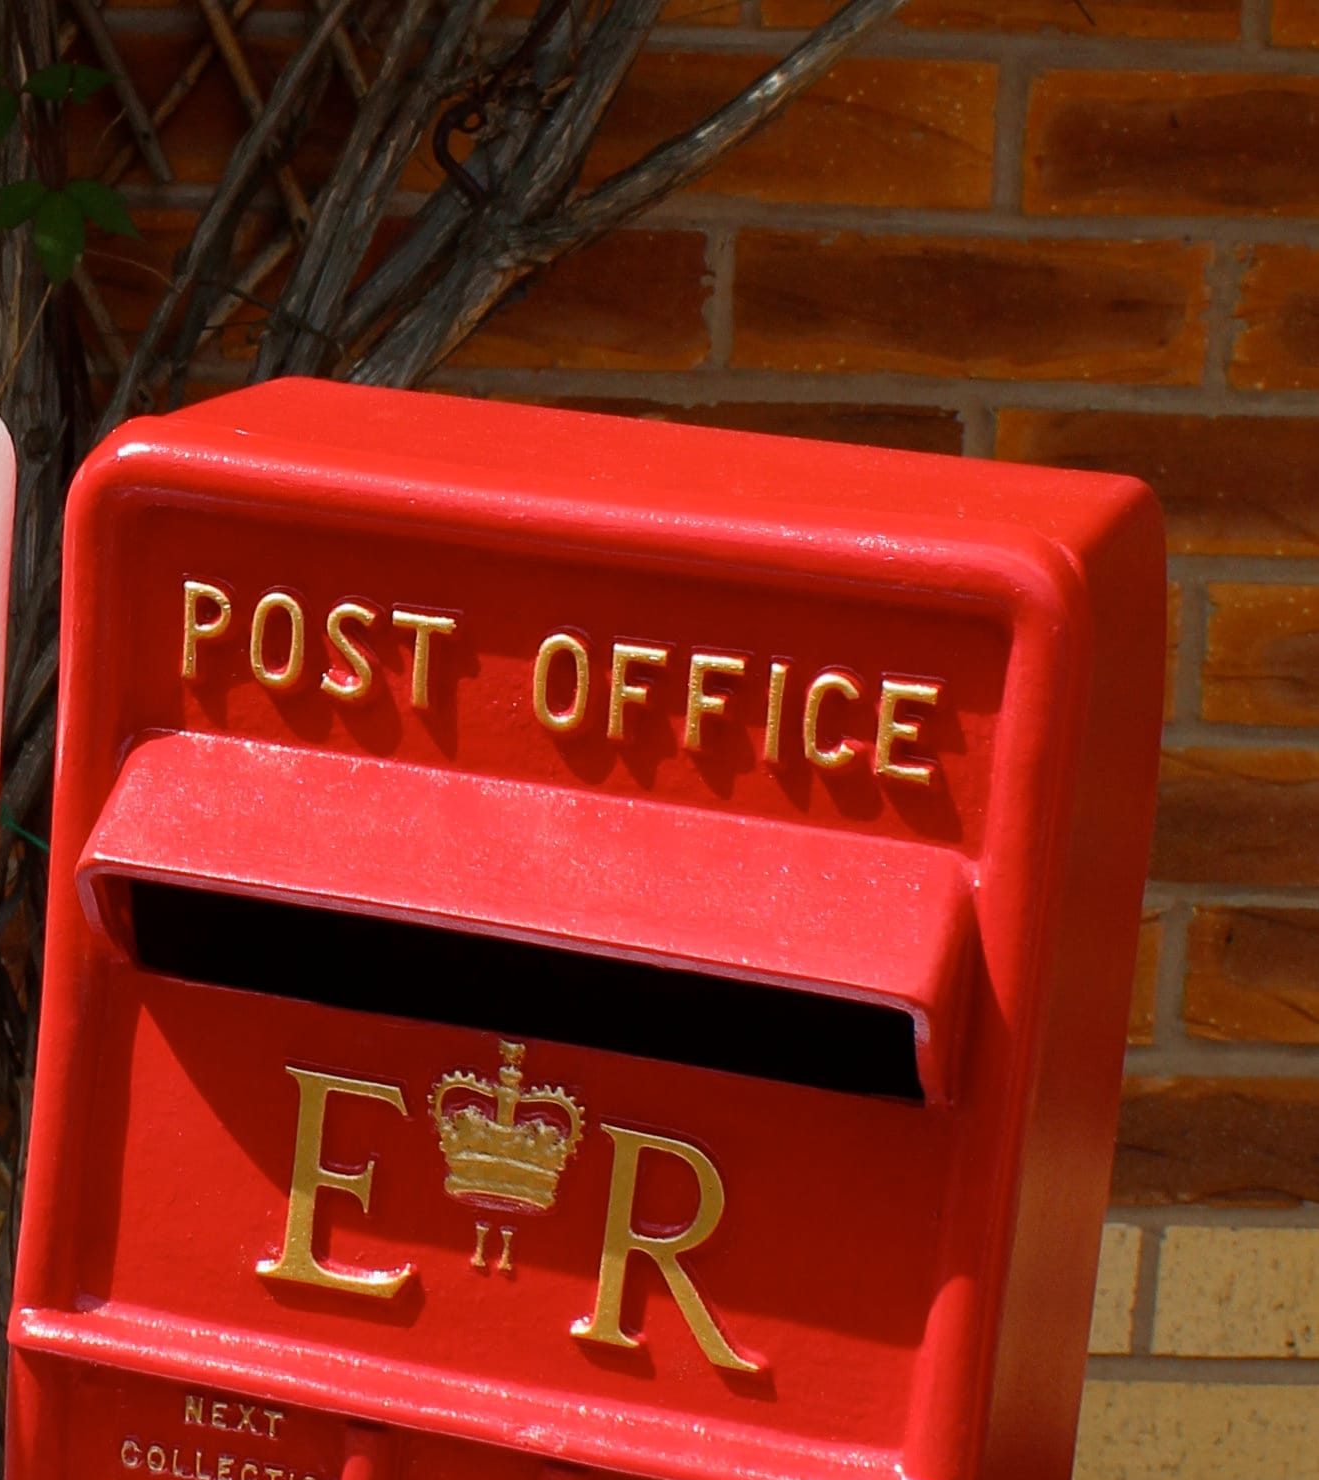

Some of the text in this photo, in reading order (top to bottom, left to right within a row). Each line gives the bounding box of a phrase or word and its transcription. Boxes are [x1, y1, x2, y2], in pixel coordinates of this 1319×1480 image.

[179, 580, 940, 785] POST OFFICE
[255, 1064, 760, 1372] E R
[469, 1223, 513, 1272] II
[184, 1396, 282, 1437] NEXT
